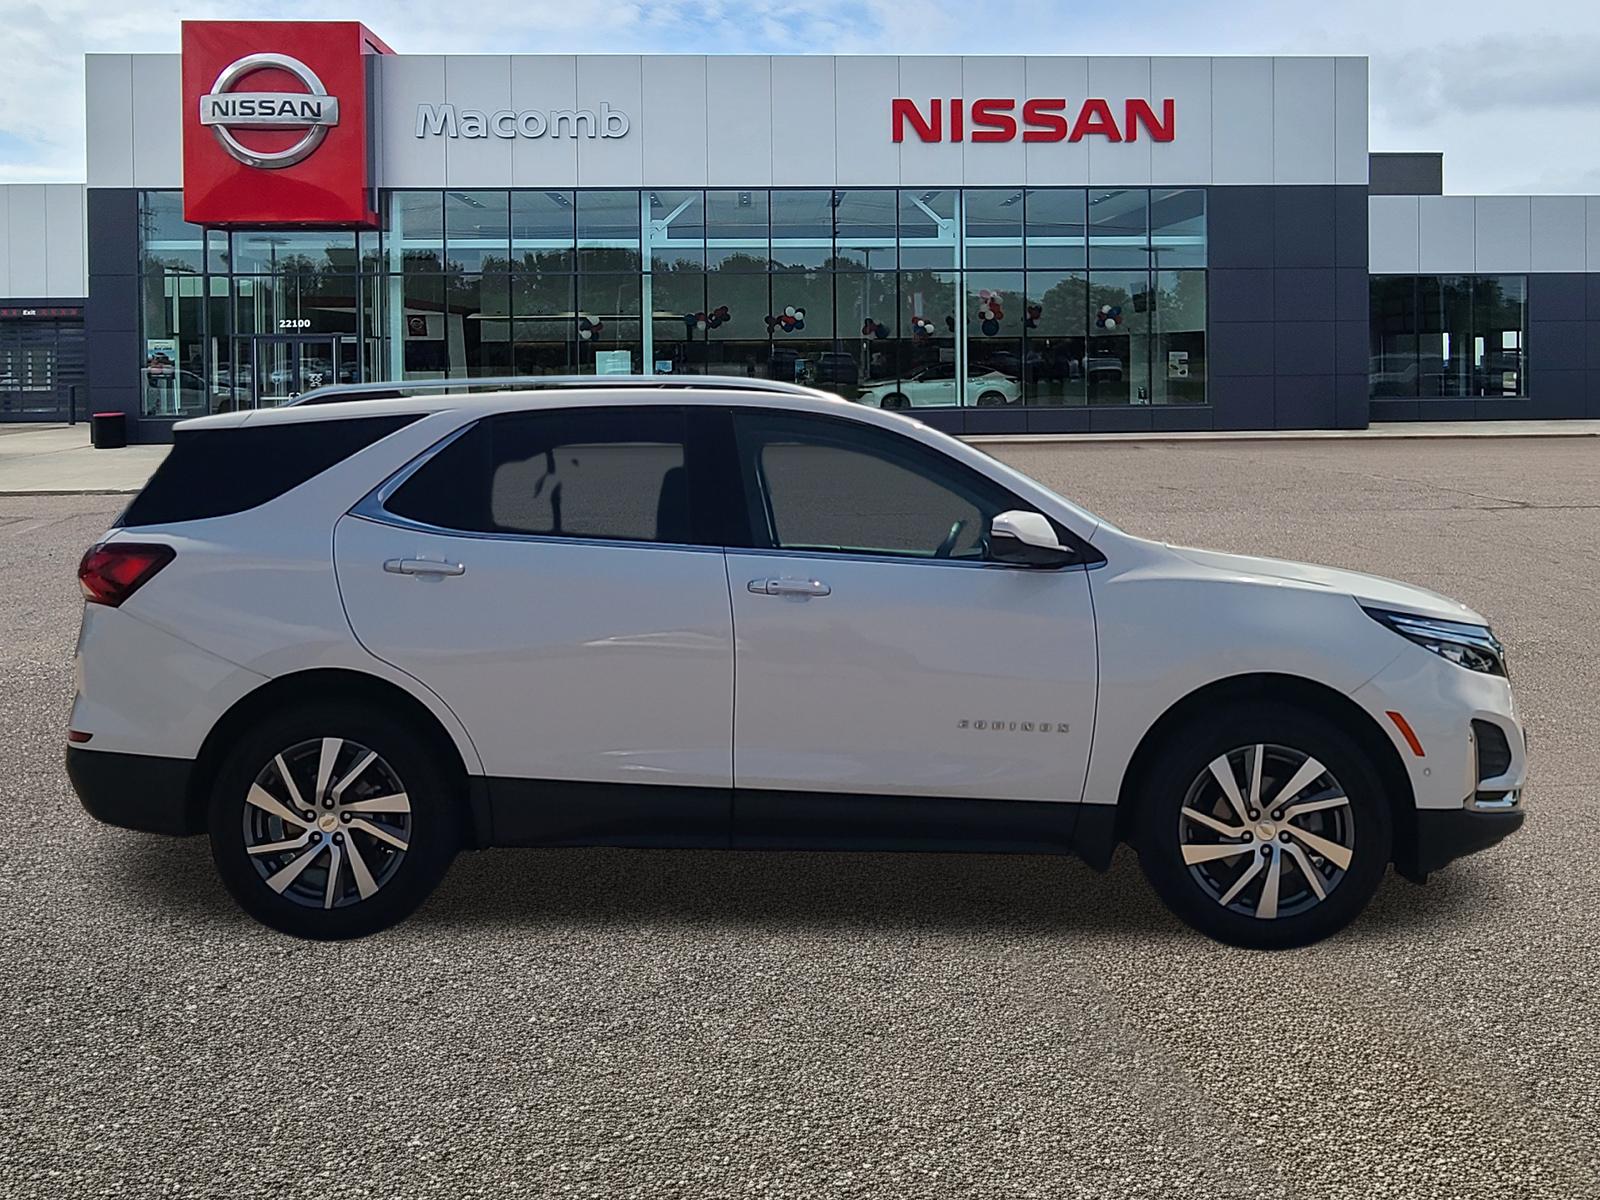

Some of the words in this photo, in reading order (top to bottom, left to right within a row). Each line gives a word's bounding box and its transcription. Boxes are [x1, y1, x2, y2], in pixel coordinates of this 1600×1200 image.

[212, 100, 321, 118] NISSAN
[415, 102, 630, 138] Macomb
[892, 98, 1175, 143] NISSAN
[279, 319, 311, 328] 22100
[957, 719, 1071, 733] EQUINOX
